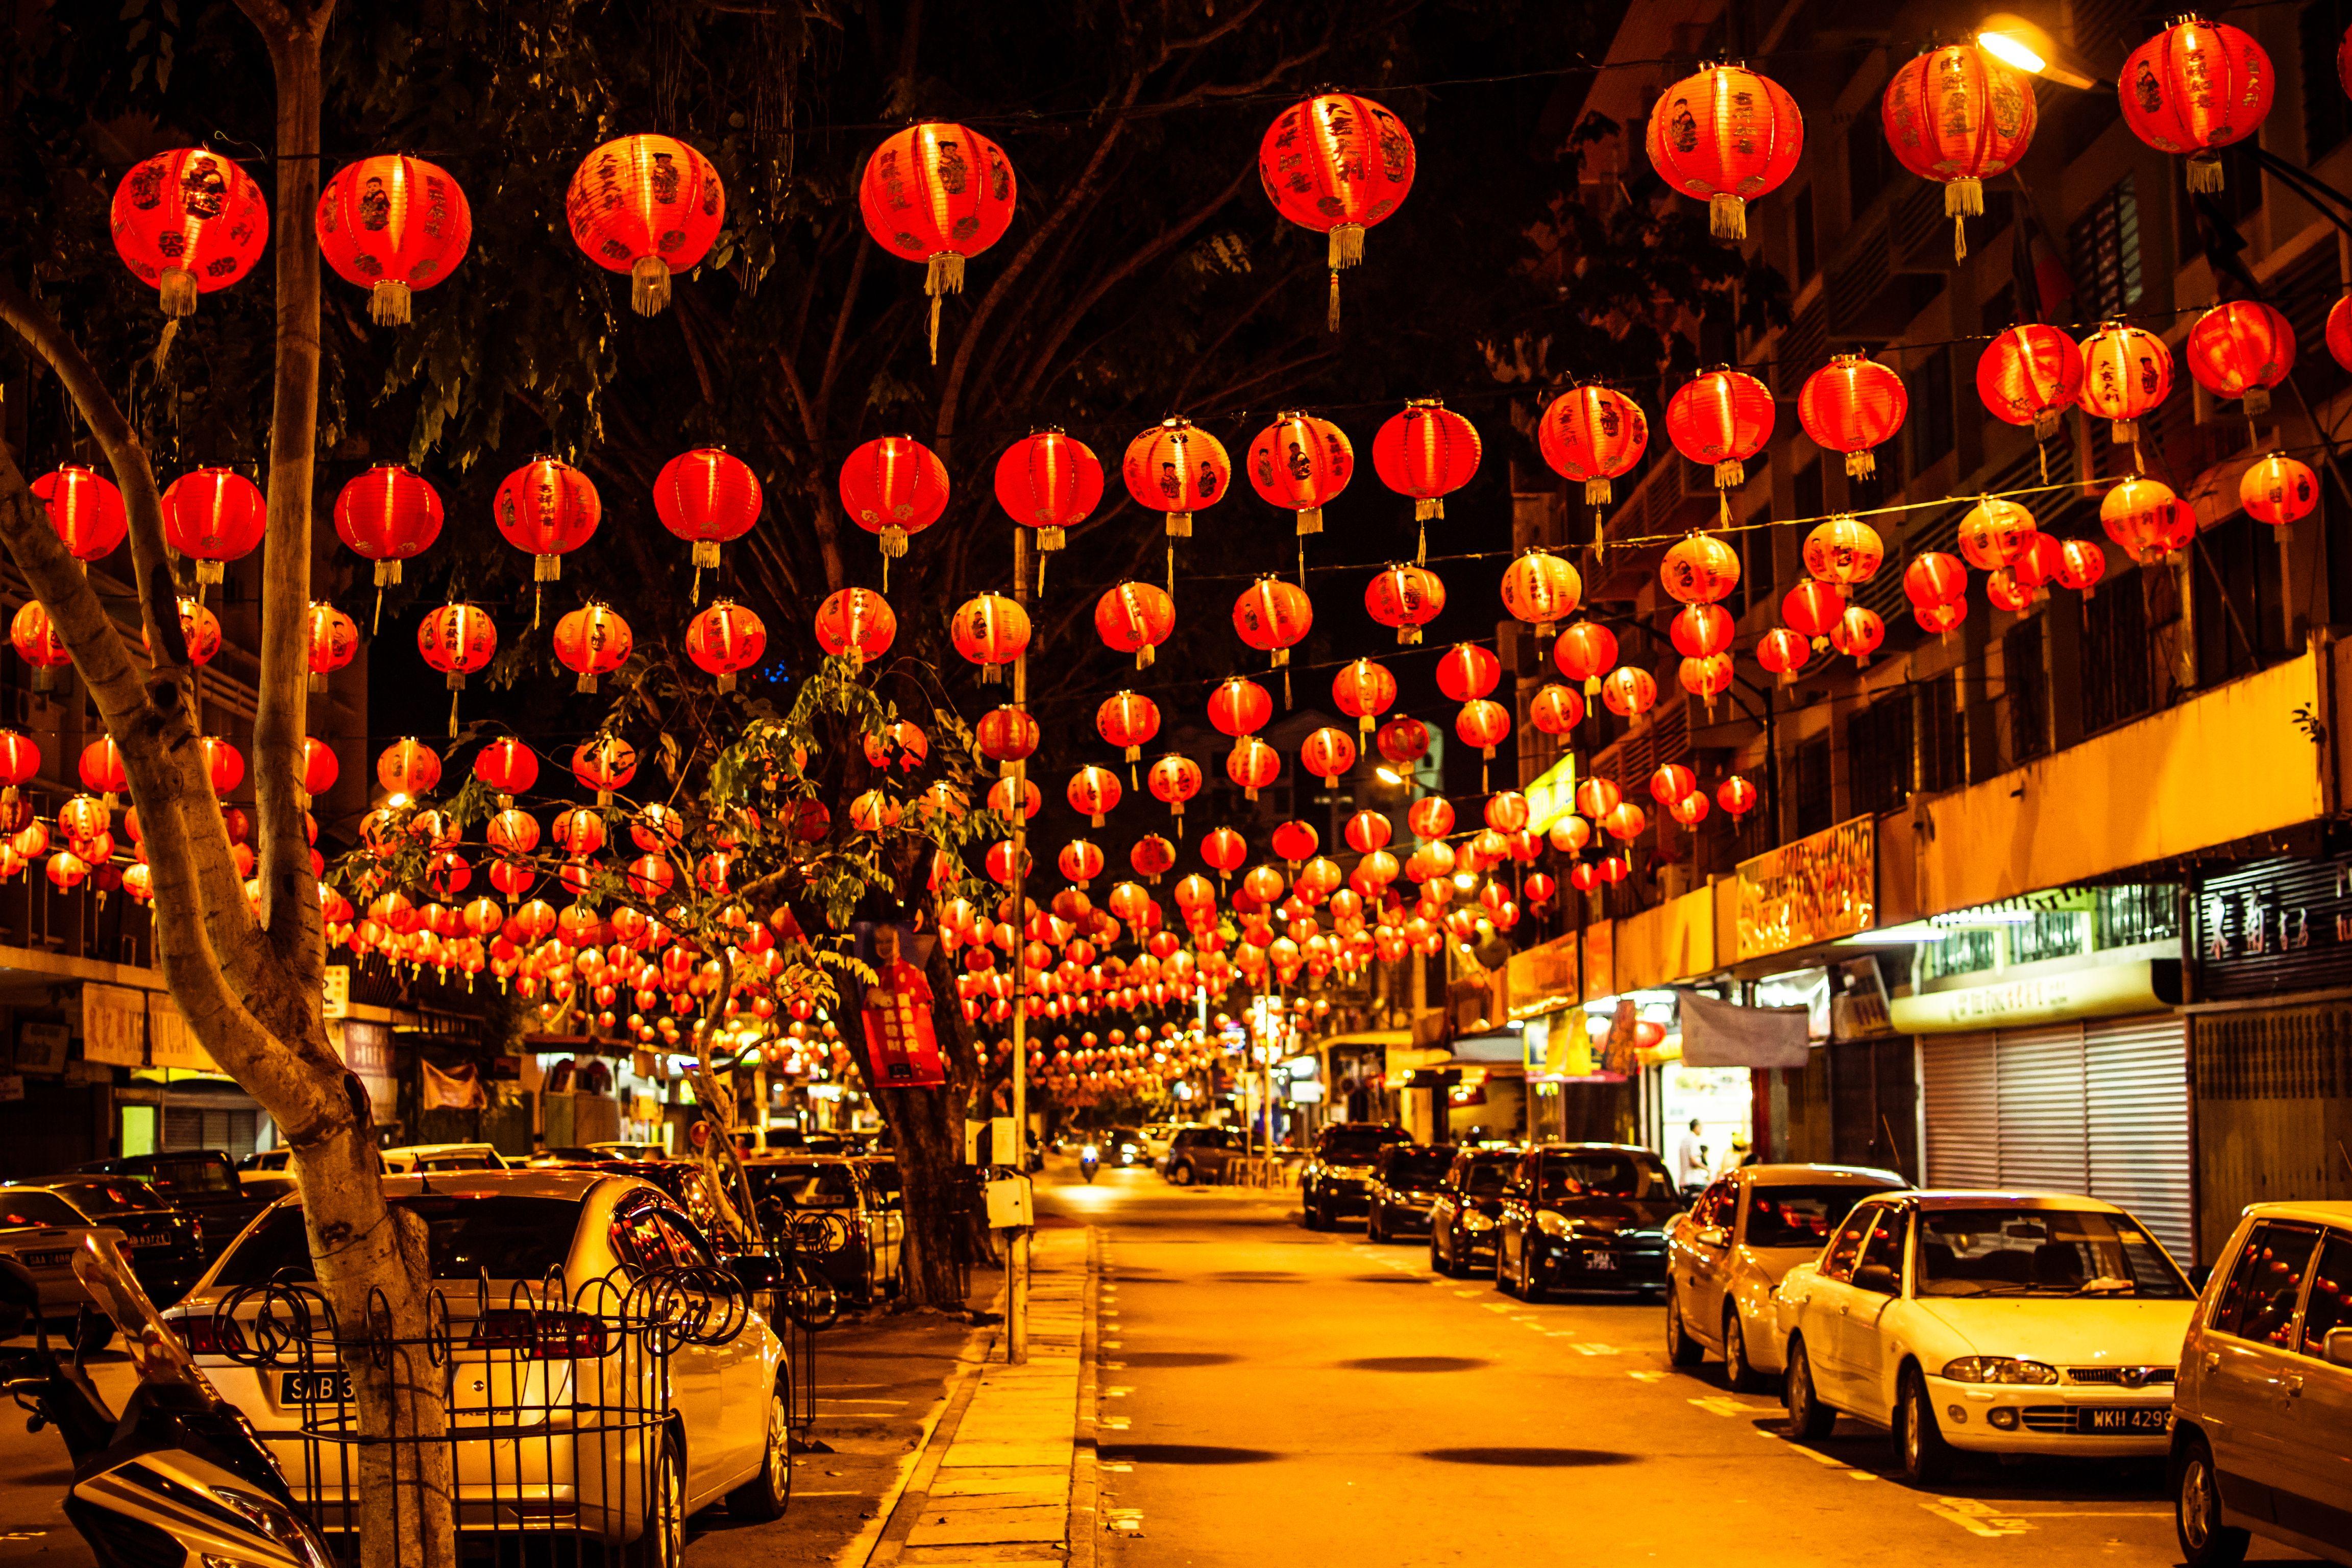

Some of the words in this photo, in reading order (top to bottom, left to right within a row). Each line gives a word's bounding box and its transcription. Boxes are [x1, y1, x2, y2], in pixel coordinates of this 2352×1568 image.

[2184, 49, 2214, 108] 吉祥如意
[1732, 92, 1758, 154] 吉祥如意
[539, 483, 556, 527] 吉祥如意
[291, 1378, 333, 1399] SAB
[2094, 1410, 2126, 1428] WKH
